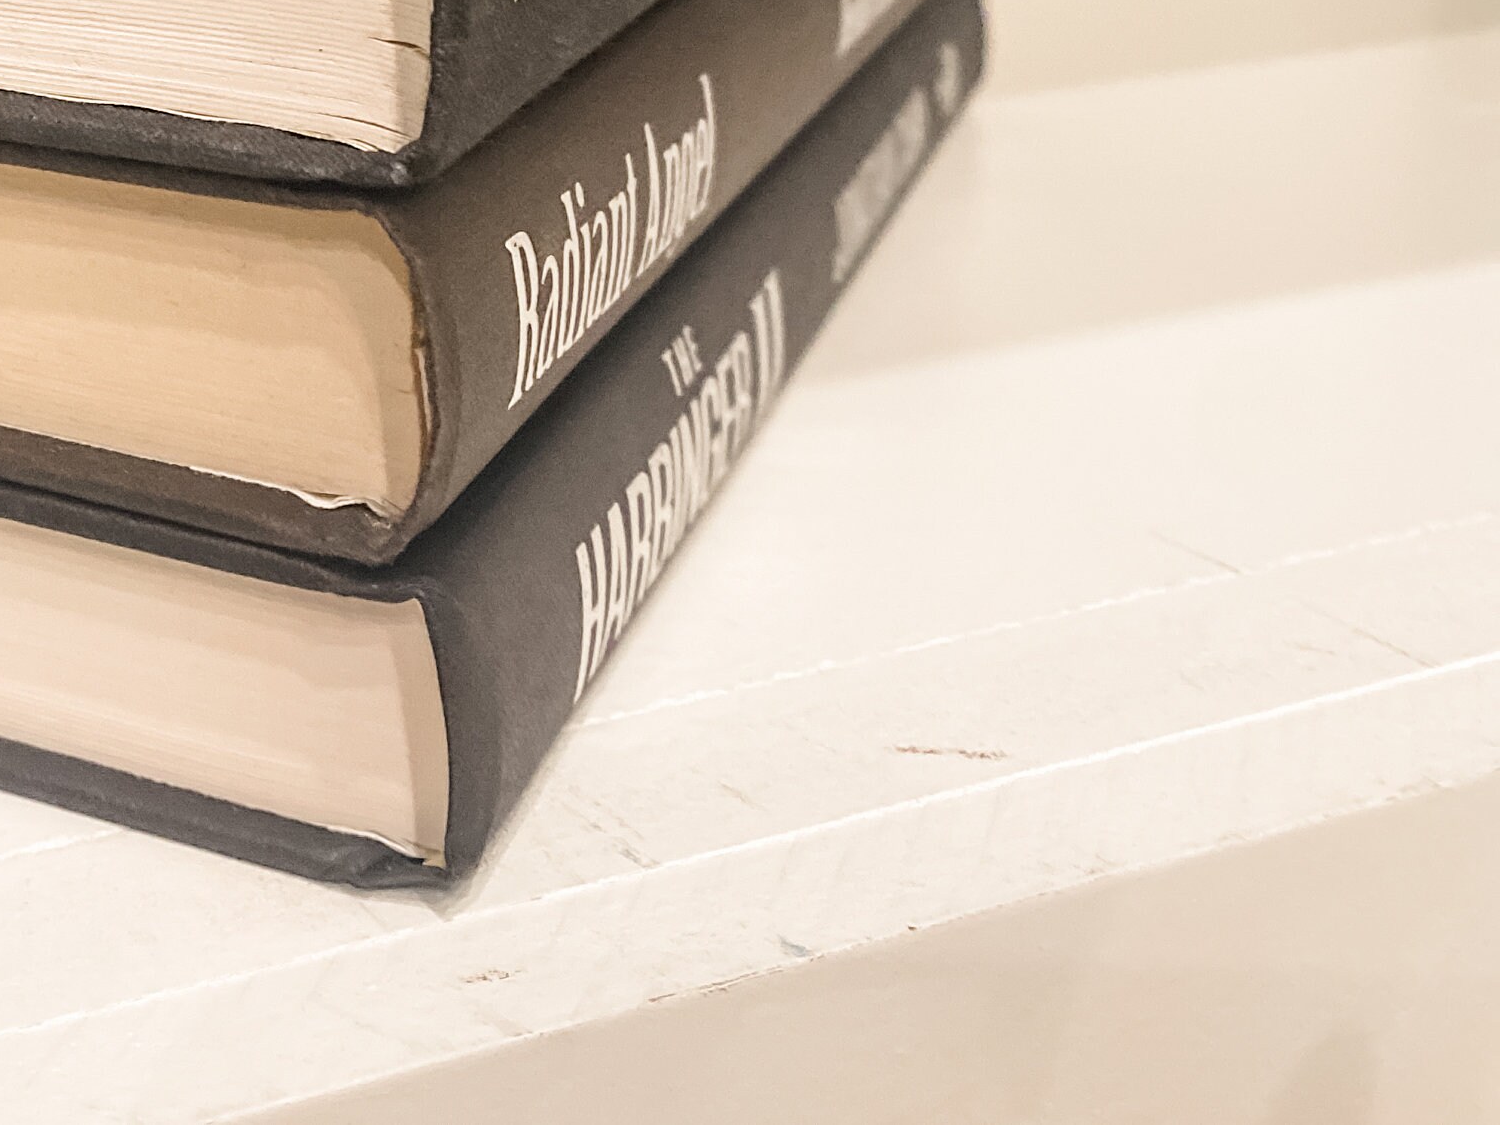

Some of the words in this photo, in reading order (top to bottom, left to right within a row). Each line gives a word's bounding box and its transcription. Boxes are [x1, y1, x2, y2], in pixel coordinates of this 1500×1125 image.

[505, 152, 638, 410] Radiant
[661, 324, 703, 397] THE
[574, 331, 754, 705] HARBINGER
